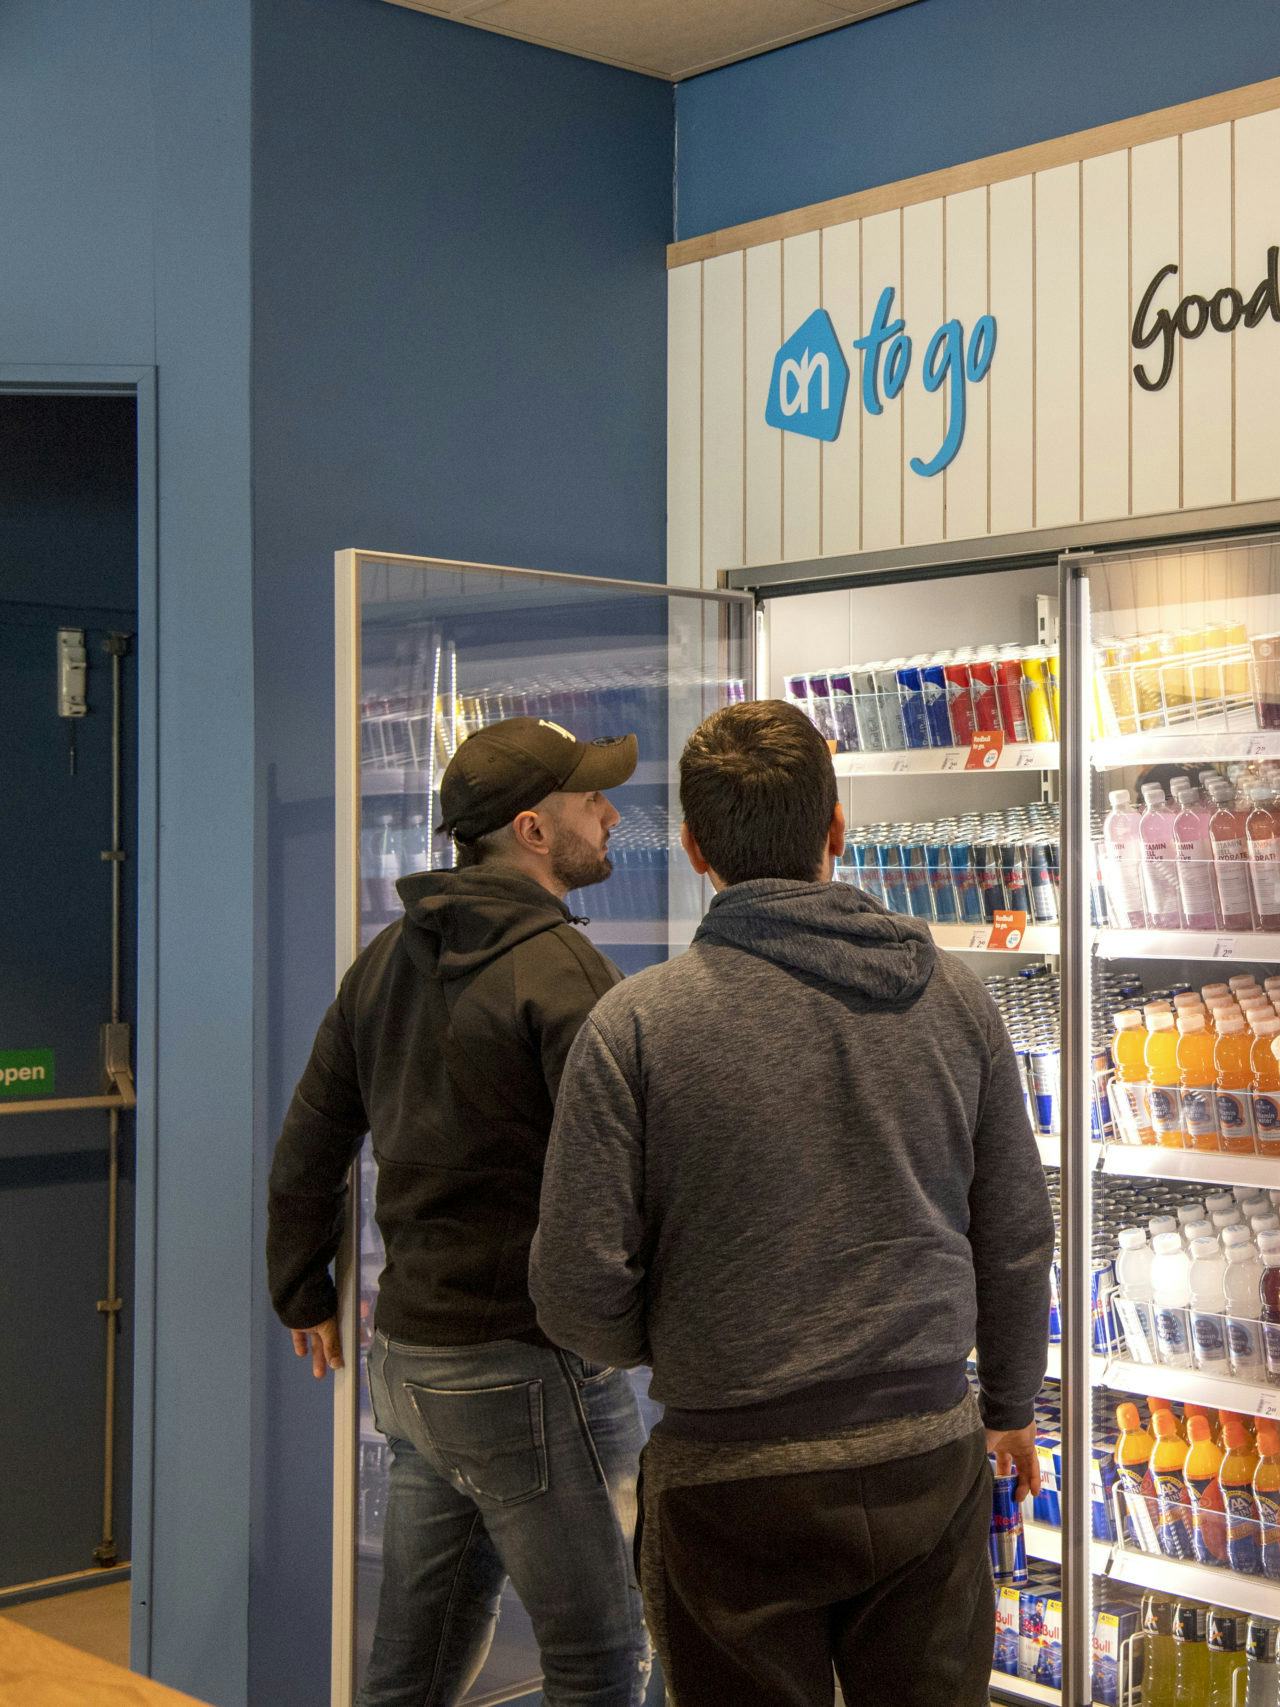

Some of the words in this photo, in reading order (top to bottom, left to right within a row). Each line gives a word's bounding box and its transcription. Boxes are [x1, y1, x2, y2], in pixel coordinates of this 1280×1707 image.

[853, 286, 911, 416] to
[910, 313, 998, 479] go
[995, 1610, 1013, 1627] Bull
[1042, 1624, 1060, 1640] Bull
[1092, 1637, 1111, 1653] Bull
